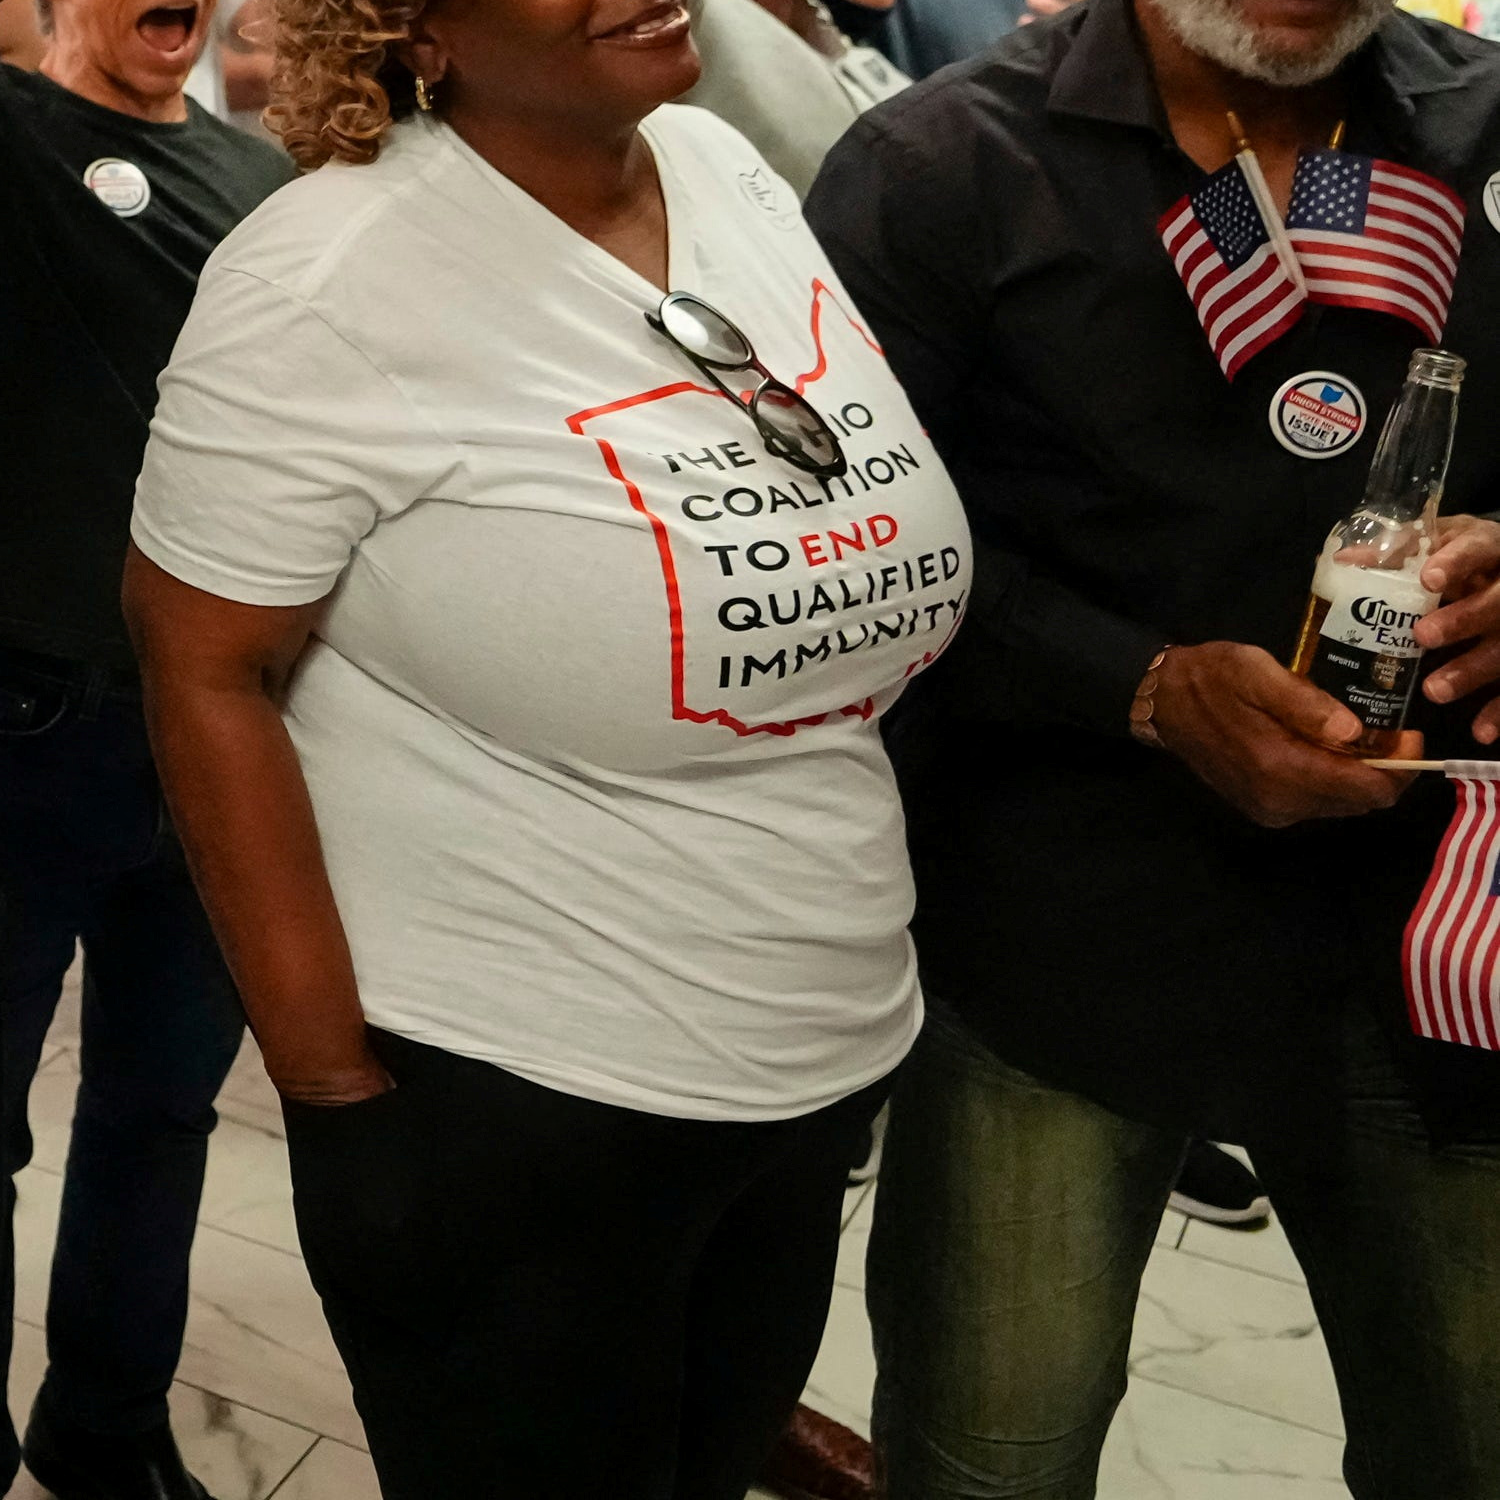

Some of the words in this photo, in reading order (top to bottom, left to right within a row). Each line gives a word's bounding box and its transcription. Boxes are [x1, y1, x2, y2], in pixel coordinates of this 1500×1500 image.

[1288, 414, 1328, 440] ISSUE
[1289, 392, 1321, 413] UNION
[1320, 405, 1358, 428] STRONG
[703, 539, 790, 577] TO
[798, 512, 899, 568] END
[717, 545, 961, 632] QUALIFIED
[1350, 596, 1422, 631] Cor
[718, 589, 967, 689] IMMUNITY
